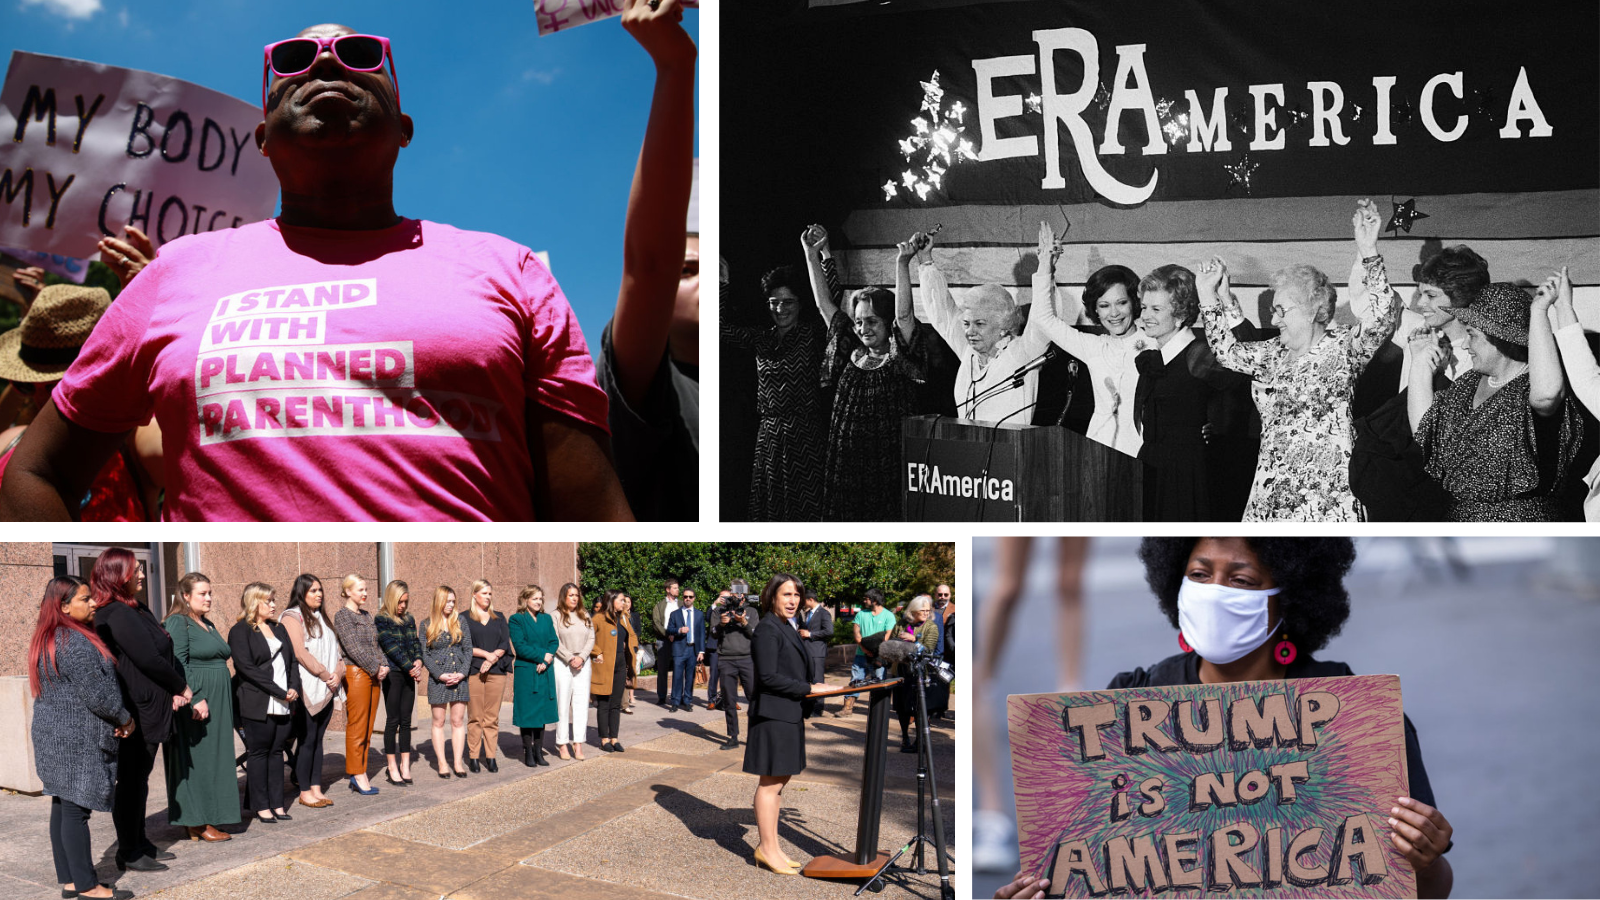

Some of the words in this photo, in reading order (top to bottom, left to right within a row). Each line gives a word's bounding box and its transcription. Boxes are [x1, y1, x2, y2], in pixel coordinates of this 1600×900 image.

[13, 85, 105, 154] MY
[126, 101, 251, 177] BODY
[0, 168, 75, 230] MY
[215, 299, 230, 317] I
[236, 283, 370, 313] STAND
[211, 317, 319, 345] WITH
[200, 348, 406, 389] PLANNED
[202, 395, 492, 437] PARENTHOOD
[907, 462, 1014, 502] ERAmerica
[1062, 692, 1341, 763] TRUMP
[1188, 760, 1310, 811] NOT
[1049, 812, 1388, 897] AMERICA
